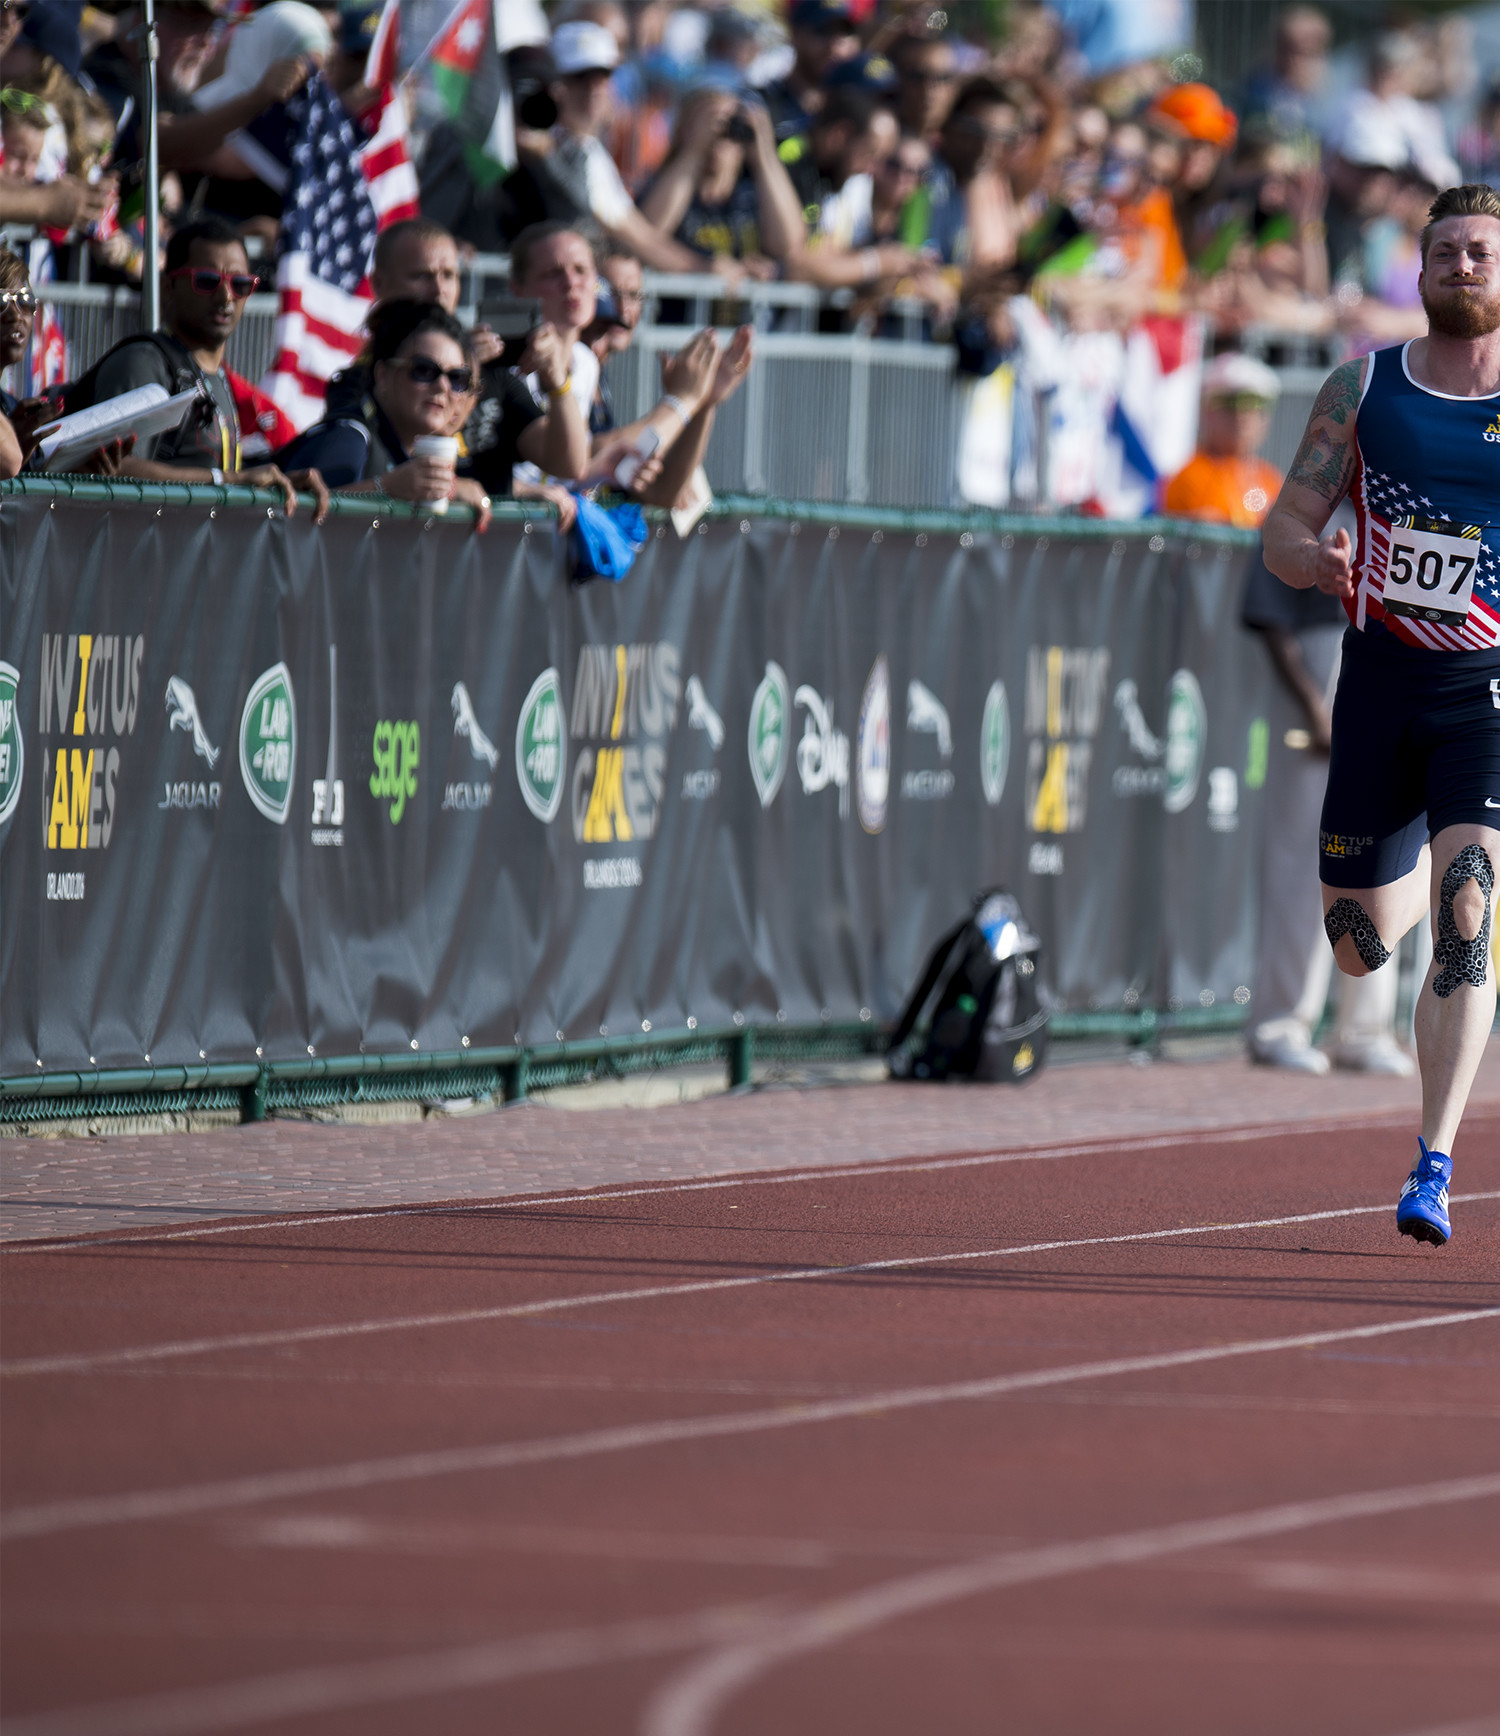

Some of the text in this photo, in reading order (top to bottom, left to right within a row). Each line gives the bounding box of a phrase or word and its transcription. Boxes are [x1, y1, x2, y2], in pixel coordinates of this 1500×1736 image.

[1390, 543, 1476, 595] 507
[369, 719, 420, 826] sage
[42, 746, 120, 850] GAMES
[157, 781, 222, 810] JAGUAR
[441, 782, 493, 811] JAGUA
[1320, 829, 1374, 847] NVICTUS
[1320, 840, 1362, 856] GAMES
